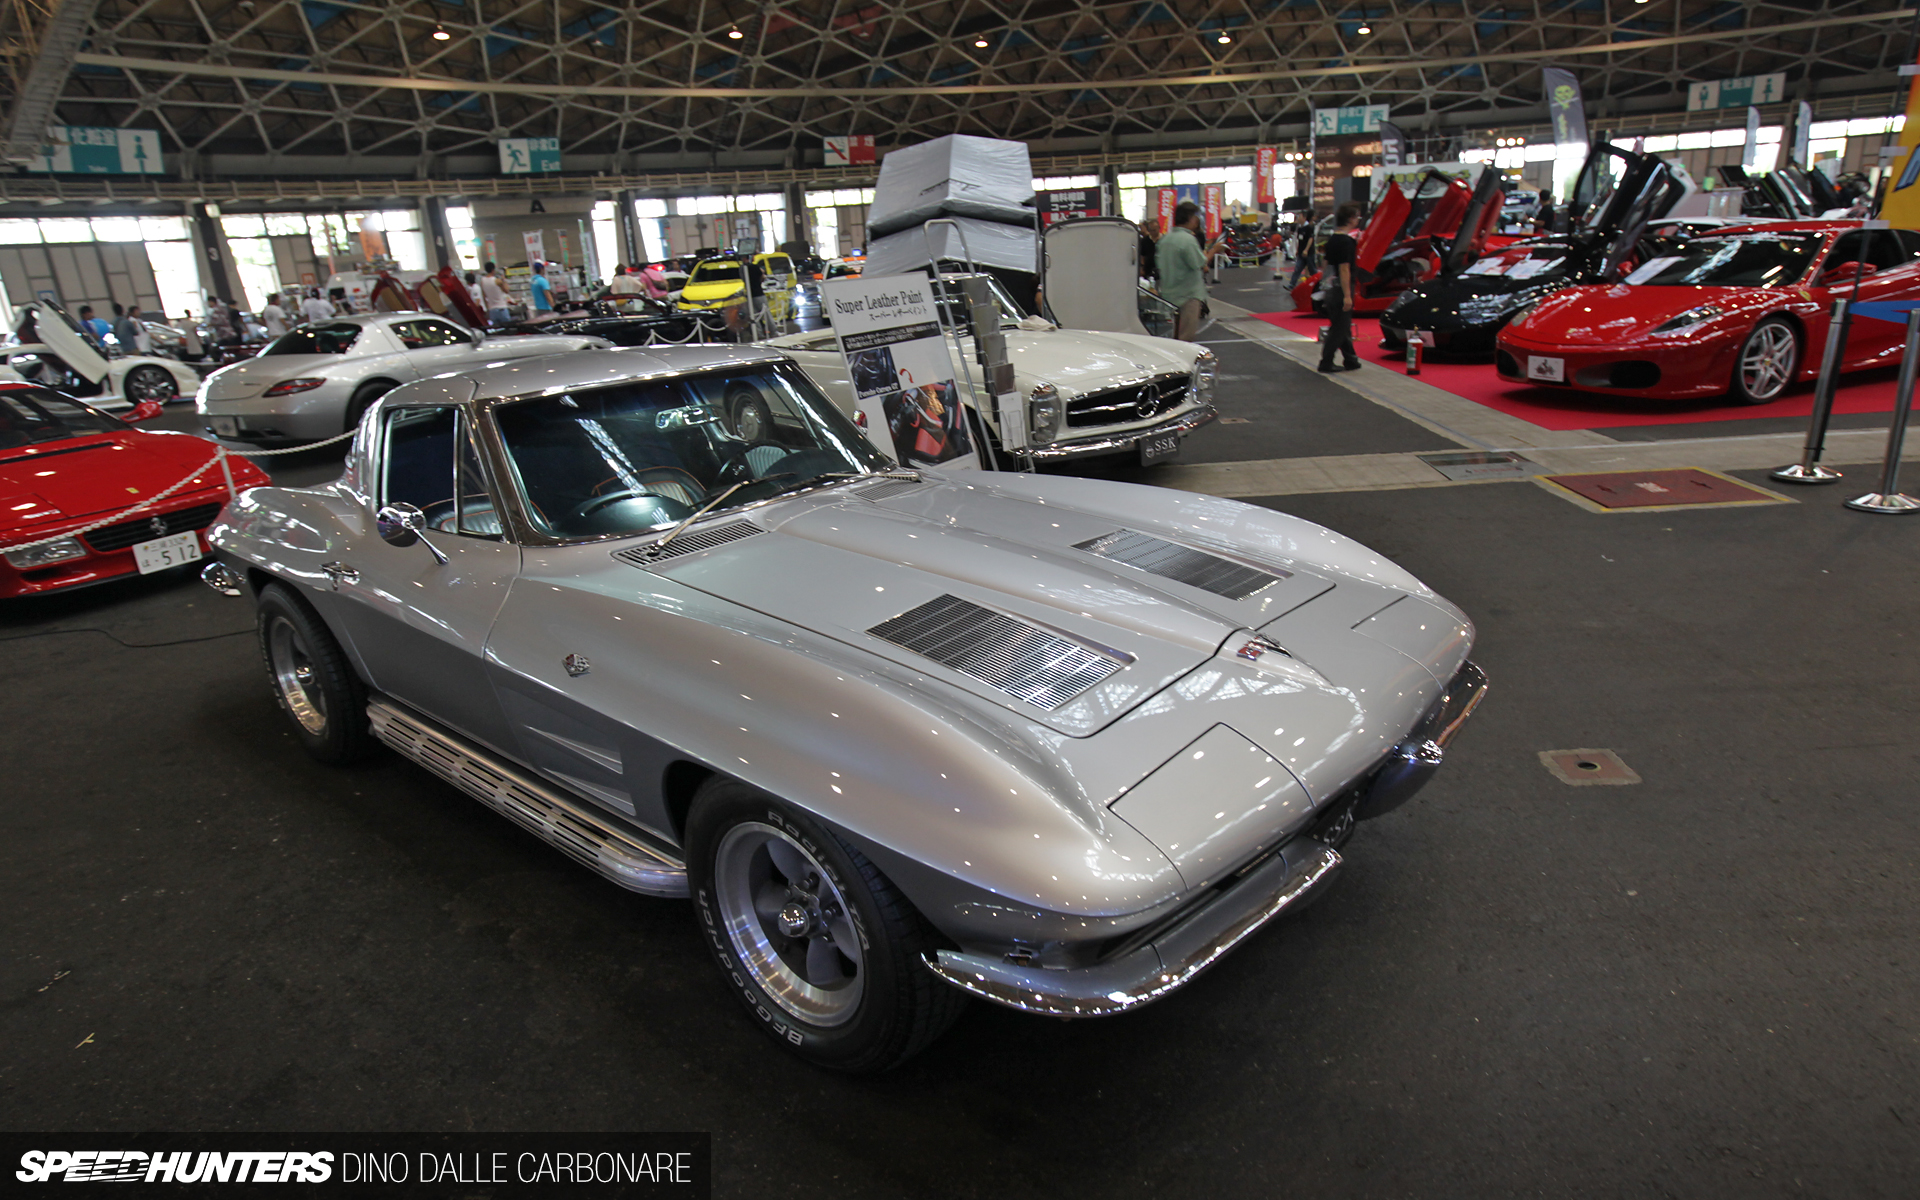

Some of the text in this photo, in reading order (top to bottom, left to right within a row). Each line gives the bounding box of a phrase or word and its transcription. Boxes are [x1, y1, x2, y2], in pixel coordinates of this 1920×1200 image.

[1341, 124, 1359, 134] Exit
[541, 160, 562, 172] Exit
[530, 199, 547, 213] A
[1051, 202, 1086, 211] コーナー
[834, 289, 924, 315] Super Leather Paint
[1154, 436, 1176, 452] SSK
[767, 810, 870, 951] Radial T/A
[698, 889, 804, 1046] BFGoodrich
